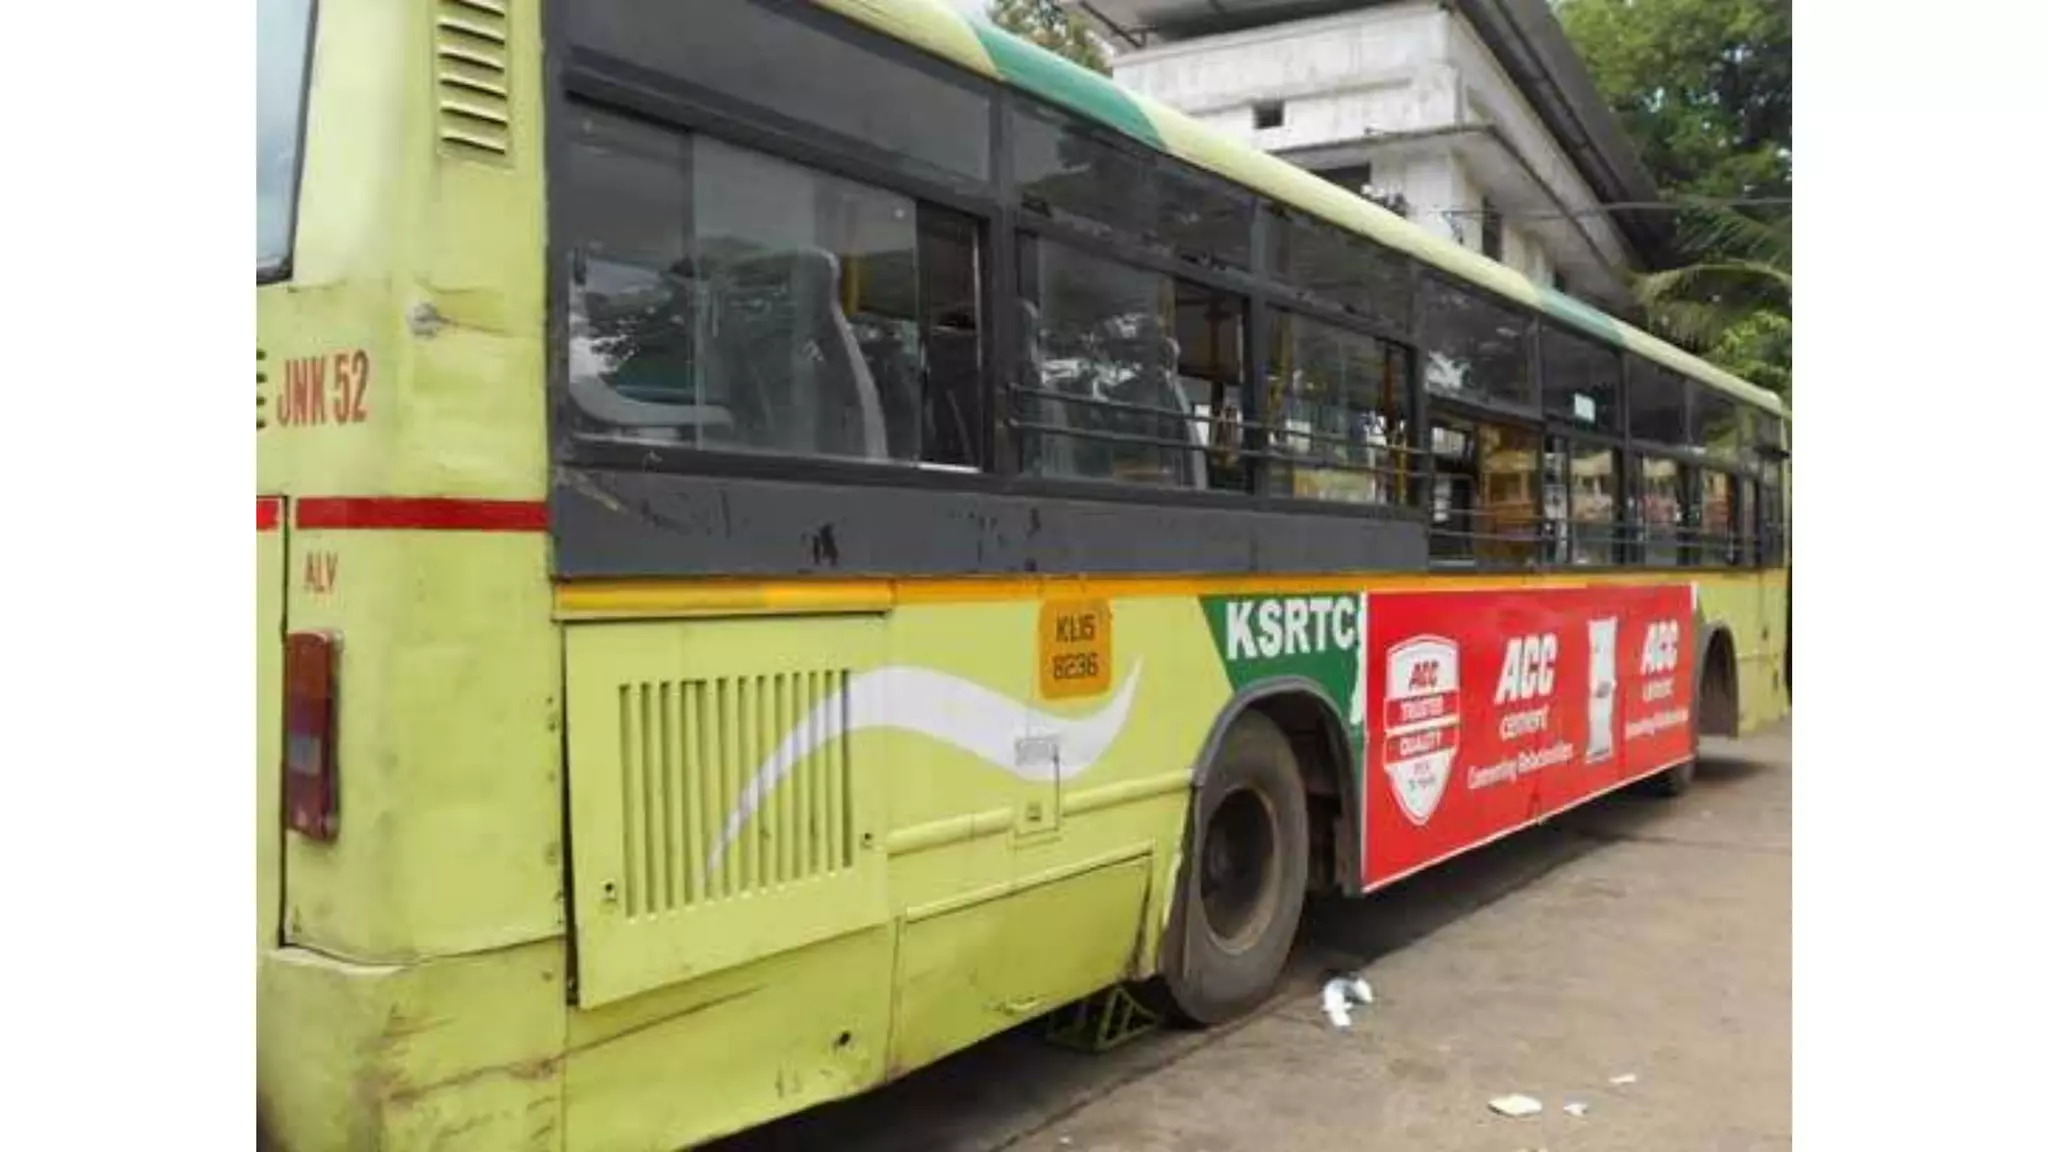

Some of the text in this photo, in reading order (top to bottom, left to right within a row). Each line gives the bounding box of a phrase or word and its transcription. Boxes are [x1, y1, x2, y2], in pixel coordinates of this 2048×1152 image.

[333, 349, 369, 427] 52
[1226, 595, 1356, 661] KSRTC
[1640, 618, 1679, 676] ACC
[1408, 660, 1440, 692] ACC
[1494, 633, 1558, 705] ACC
